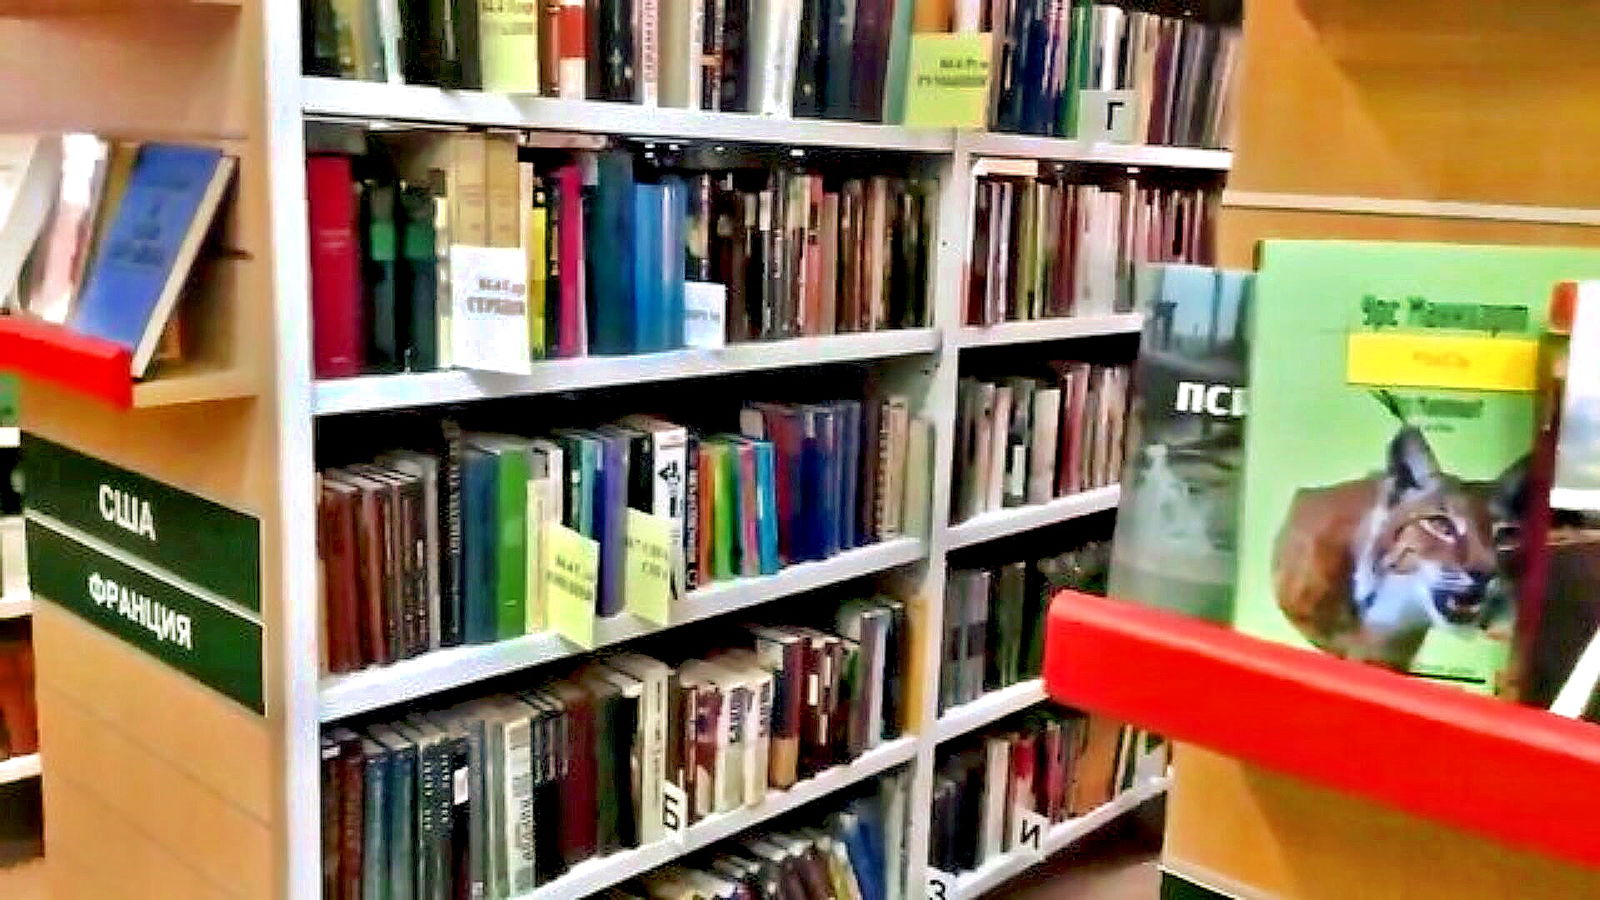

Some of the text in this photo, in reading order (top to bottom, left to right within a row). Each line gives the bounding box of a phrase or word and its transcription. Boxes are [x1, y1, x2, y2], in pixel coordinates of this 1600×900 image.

[1107, 101, 1125, 130] Г
[99, 484, 157, 541] США
[86, 571, 193, 650] ФРАНЦИЯ
[663, 794, 678, 832] Б
[1019, 819, 1041, 851] И
